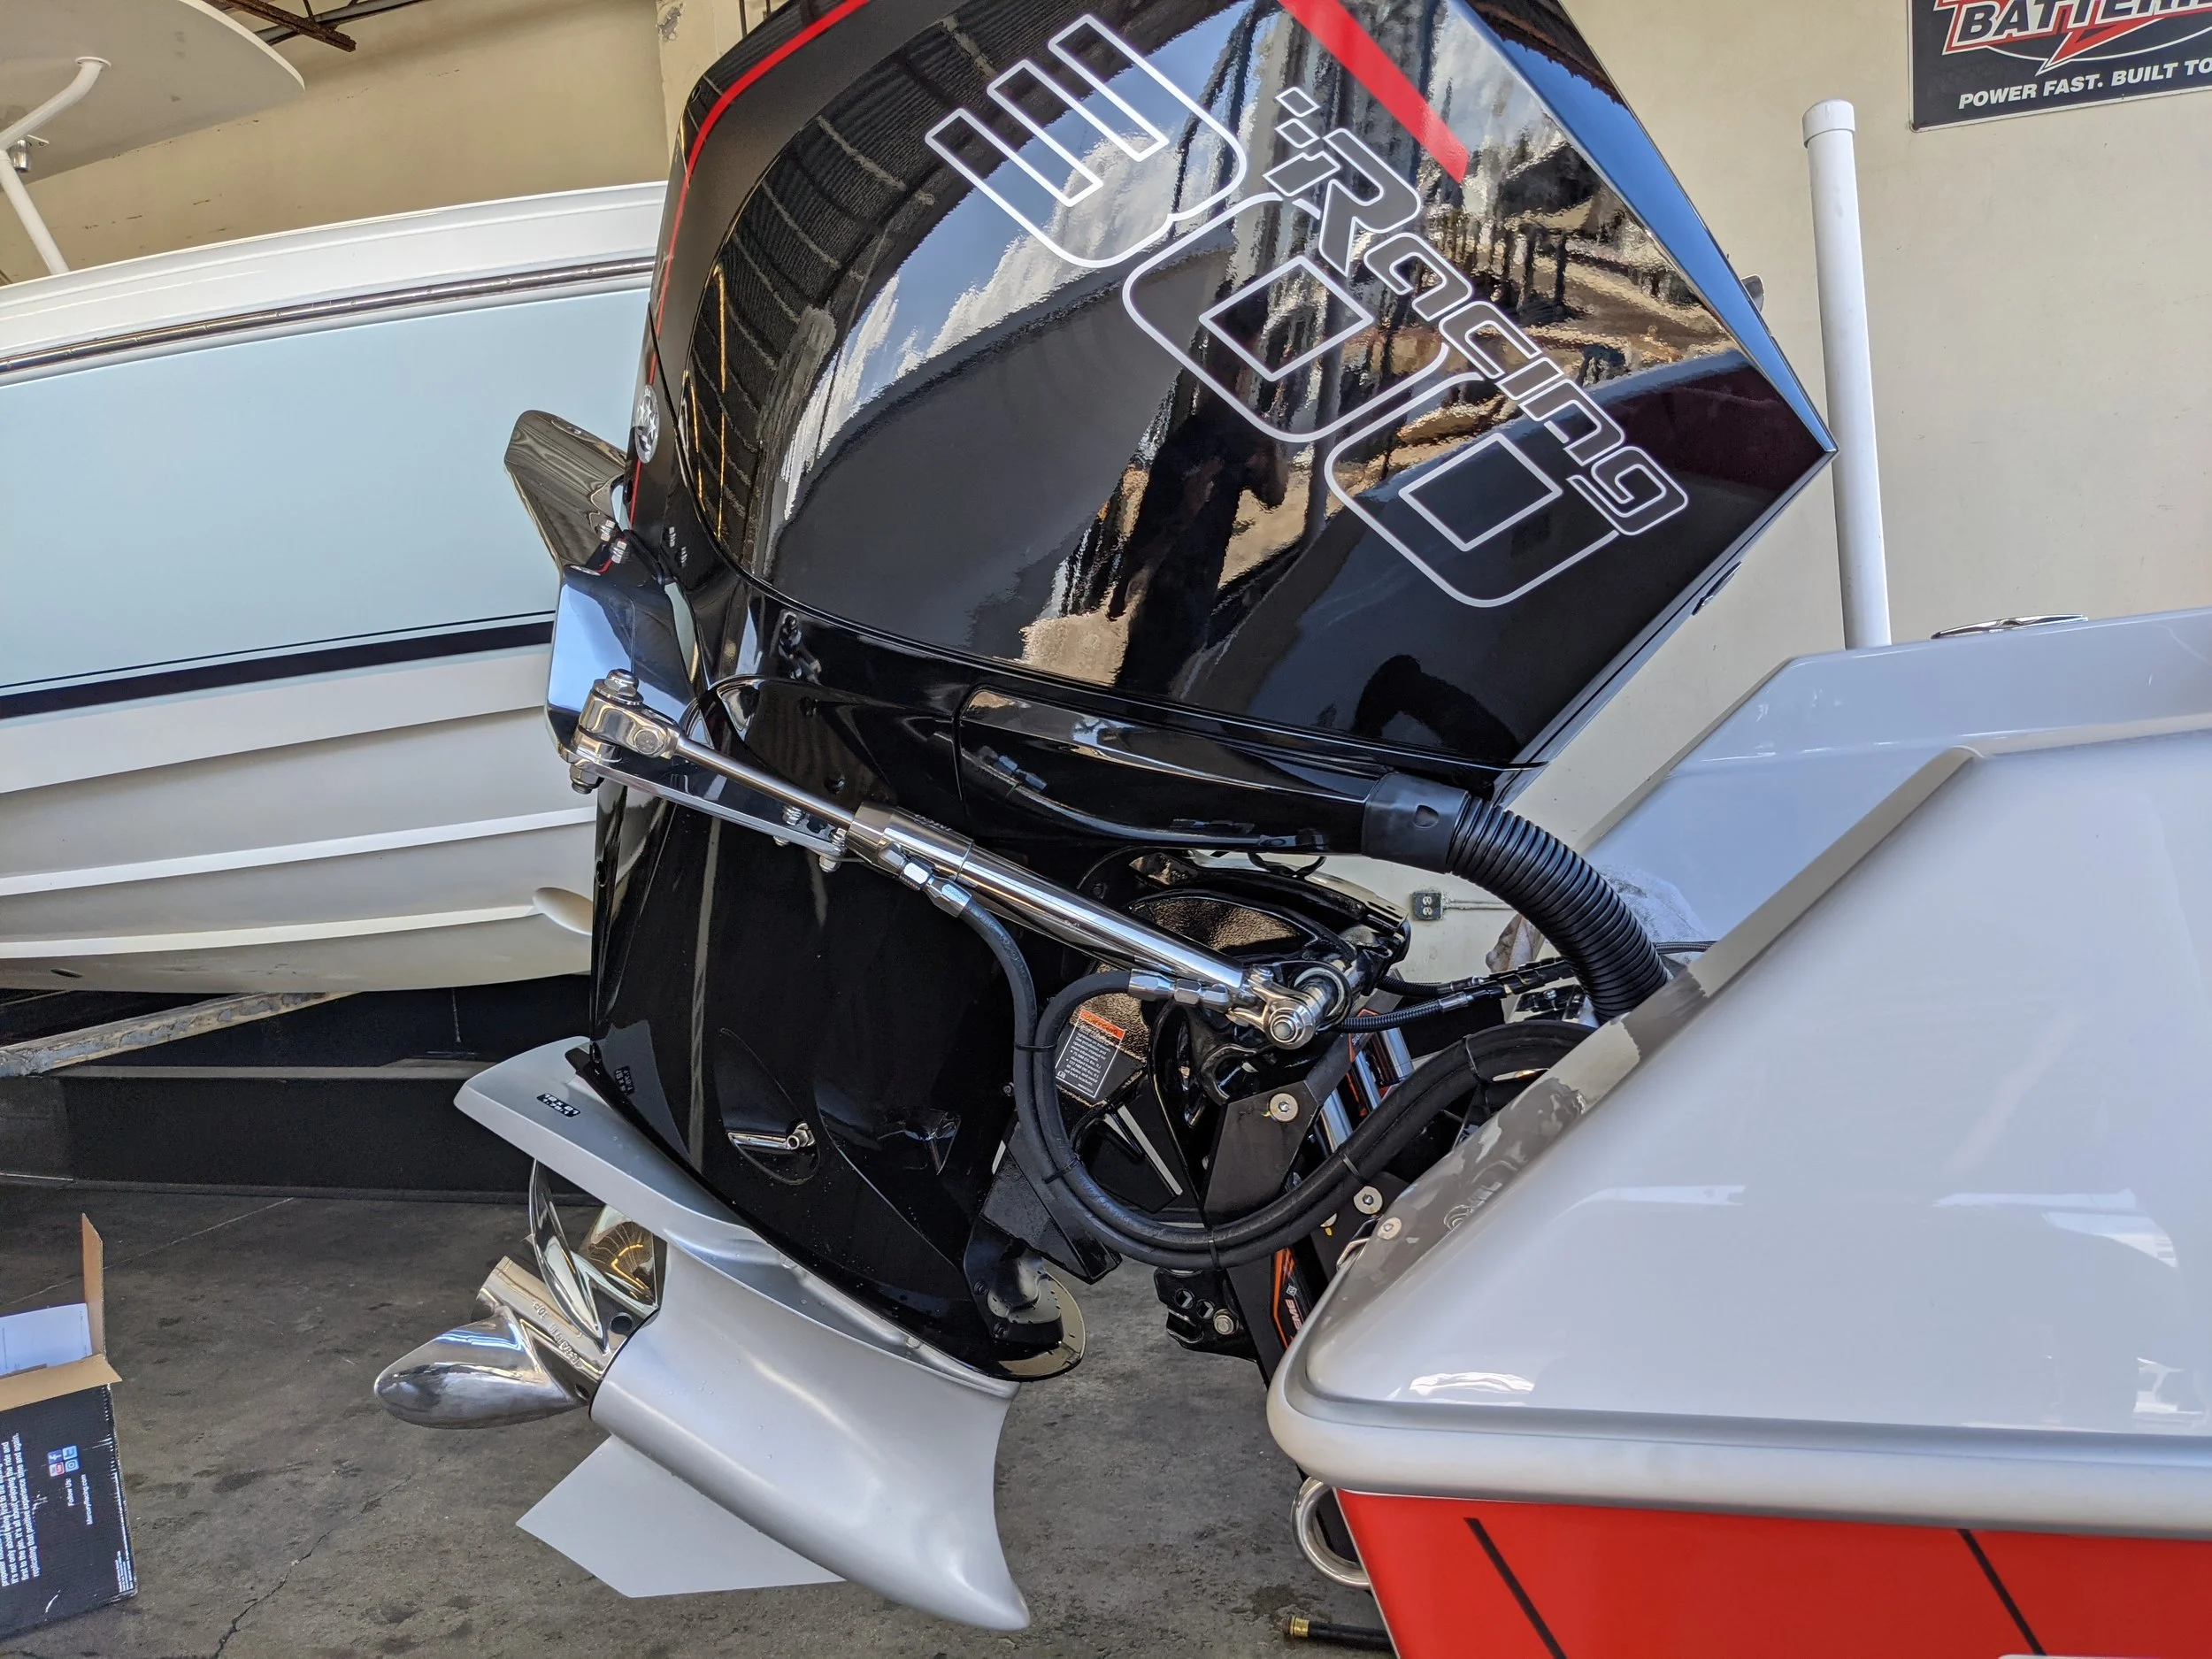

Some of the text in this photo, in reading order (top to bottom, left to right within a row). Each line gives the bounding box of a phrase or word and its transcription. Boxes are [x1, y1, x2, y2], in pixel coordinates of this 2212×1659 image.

[1958, 84, 2038, 110] POWER
[2043, 73, 2103, 97] FAST.
[2111, 61, 2178, 87] BUILT
[925, 13, 1619, 609] 300
[1263, 88, 1689, 536] Racing
[0, 1440, 10, 1454] and
[13, 1451, 22, 1463] and
[19, 1478, 30, 1509] experience
[65, 1487, 74, 1506] Follow
[81, 1473, 93, 1525] MercuryRacing.com
[8, 1562, 18, 1573] not
